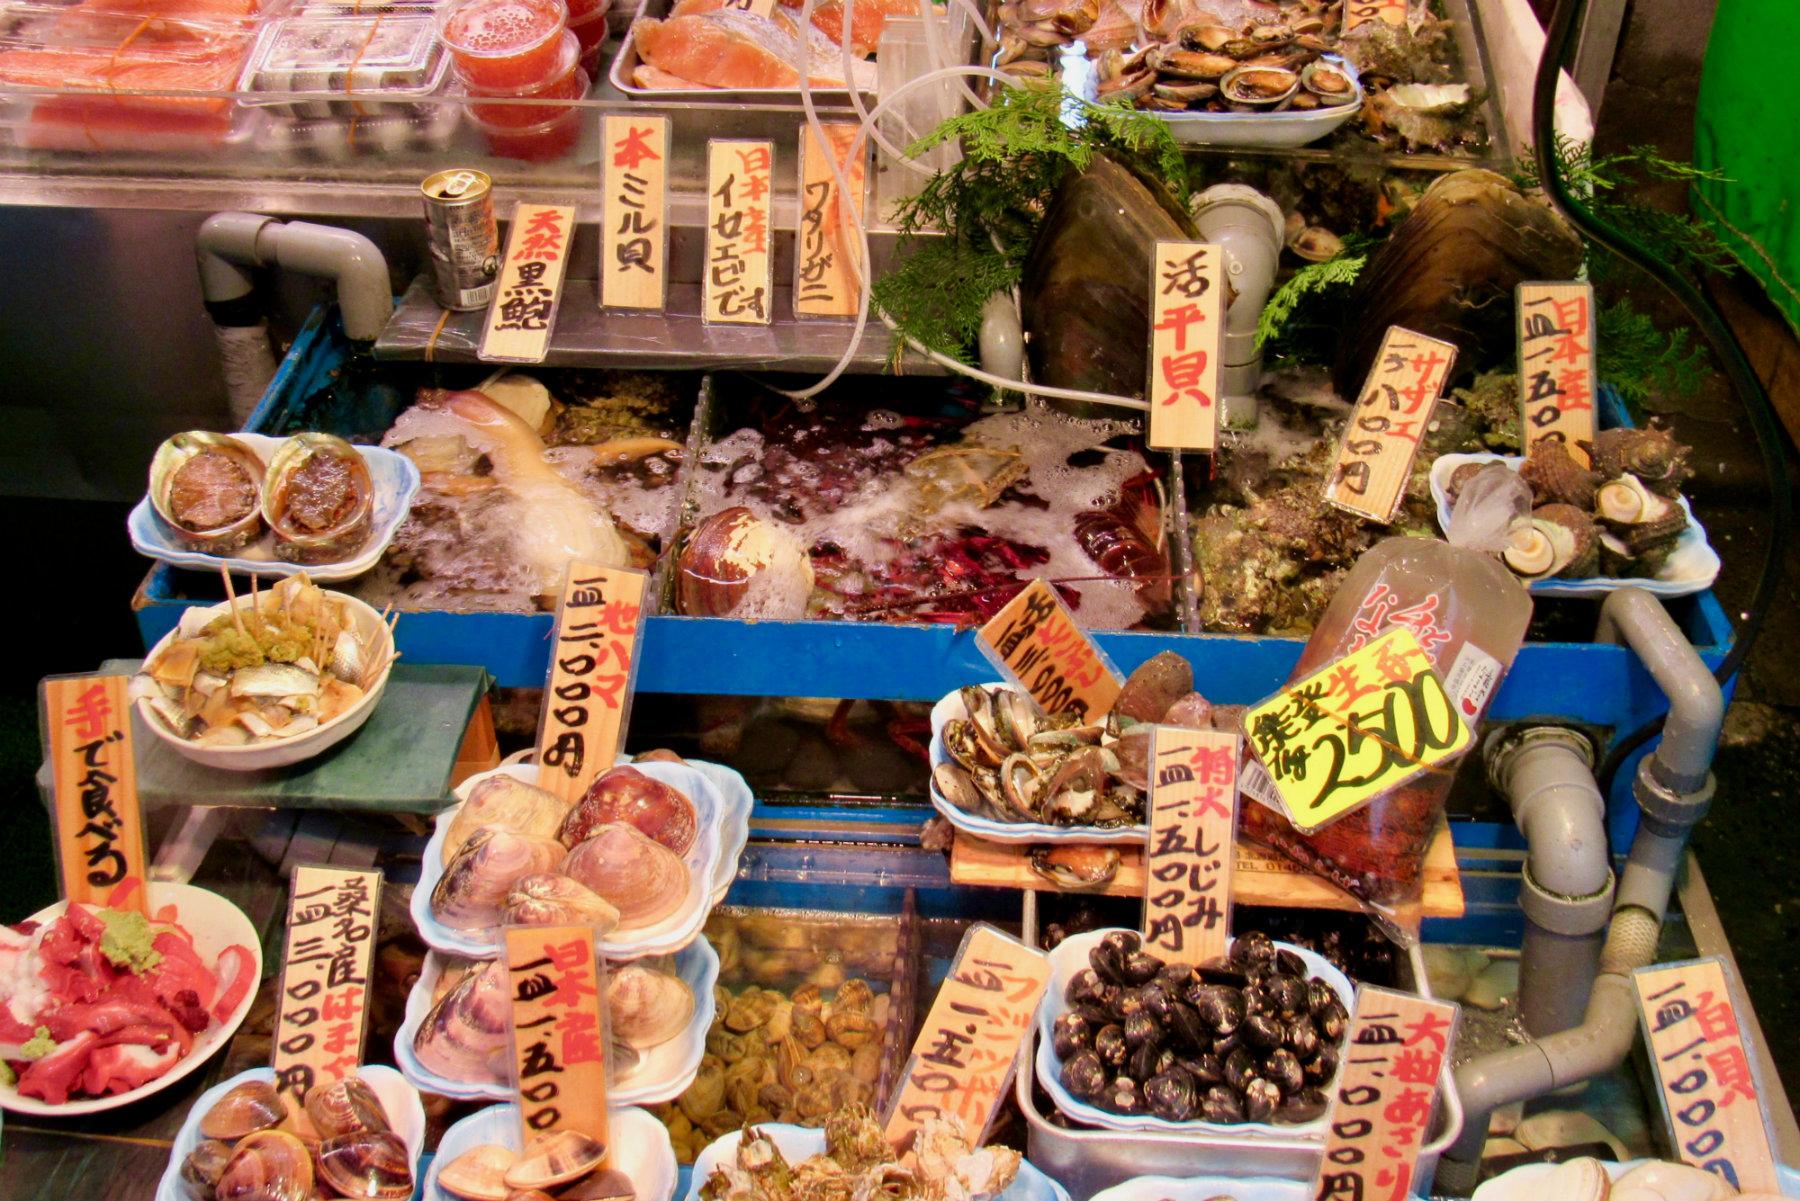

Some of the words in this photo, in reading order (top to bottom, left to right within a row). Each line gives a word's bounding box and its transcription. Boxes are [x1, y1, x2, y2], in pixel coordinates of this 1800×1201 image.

[614, 127, 661, 273] 本ミル貝
[736, 147, 769, 254] 日本産
[1154, 249, 1211, 407] 活平貝
[1551, 296, 1592, 412] 日本産
[1384, 351, 1446, 444] サザエ
[1310, 669, 1459, 808] 2500
